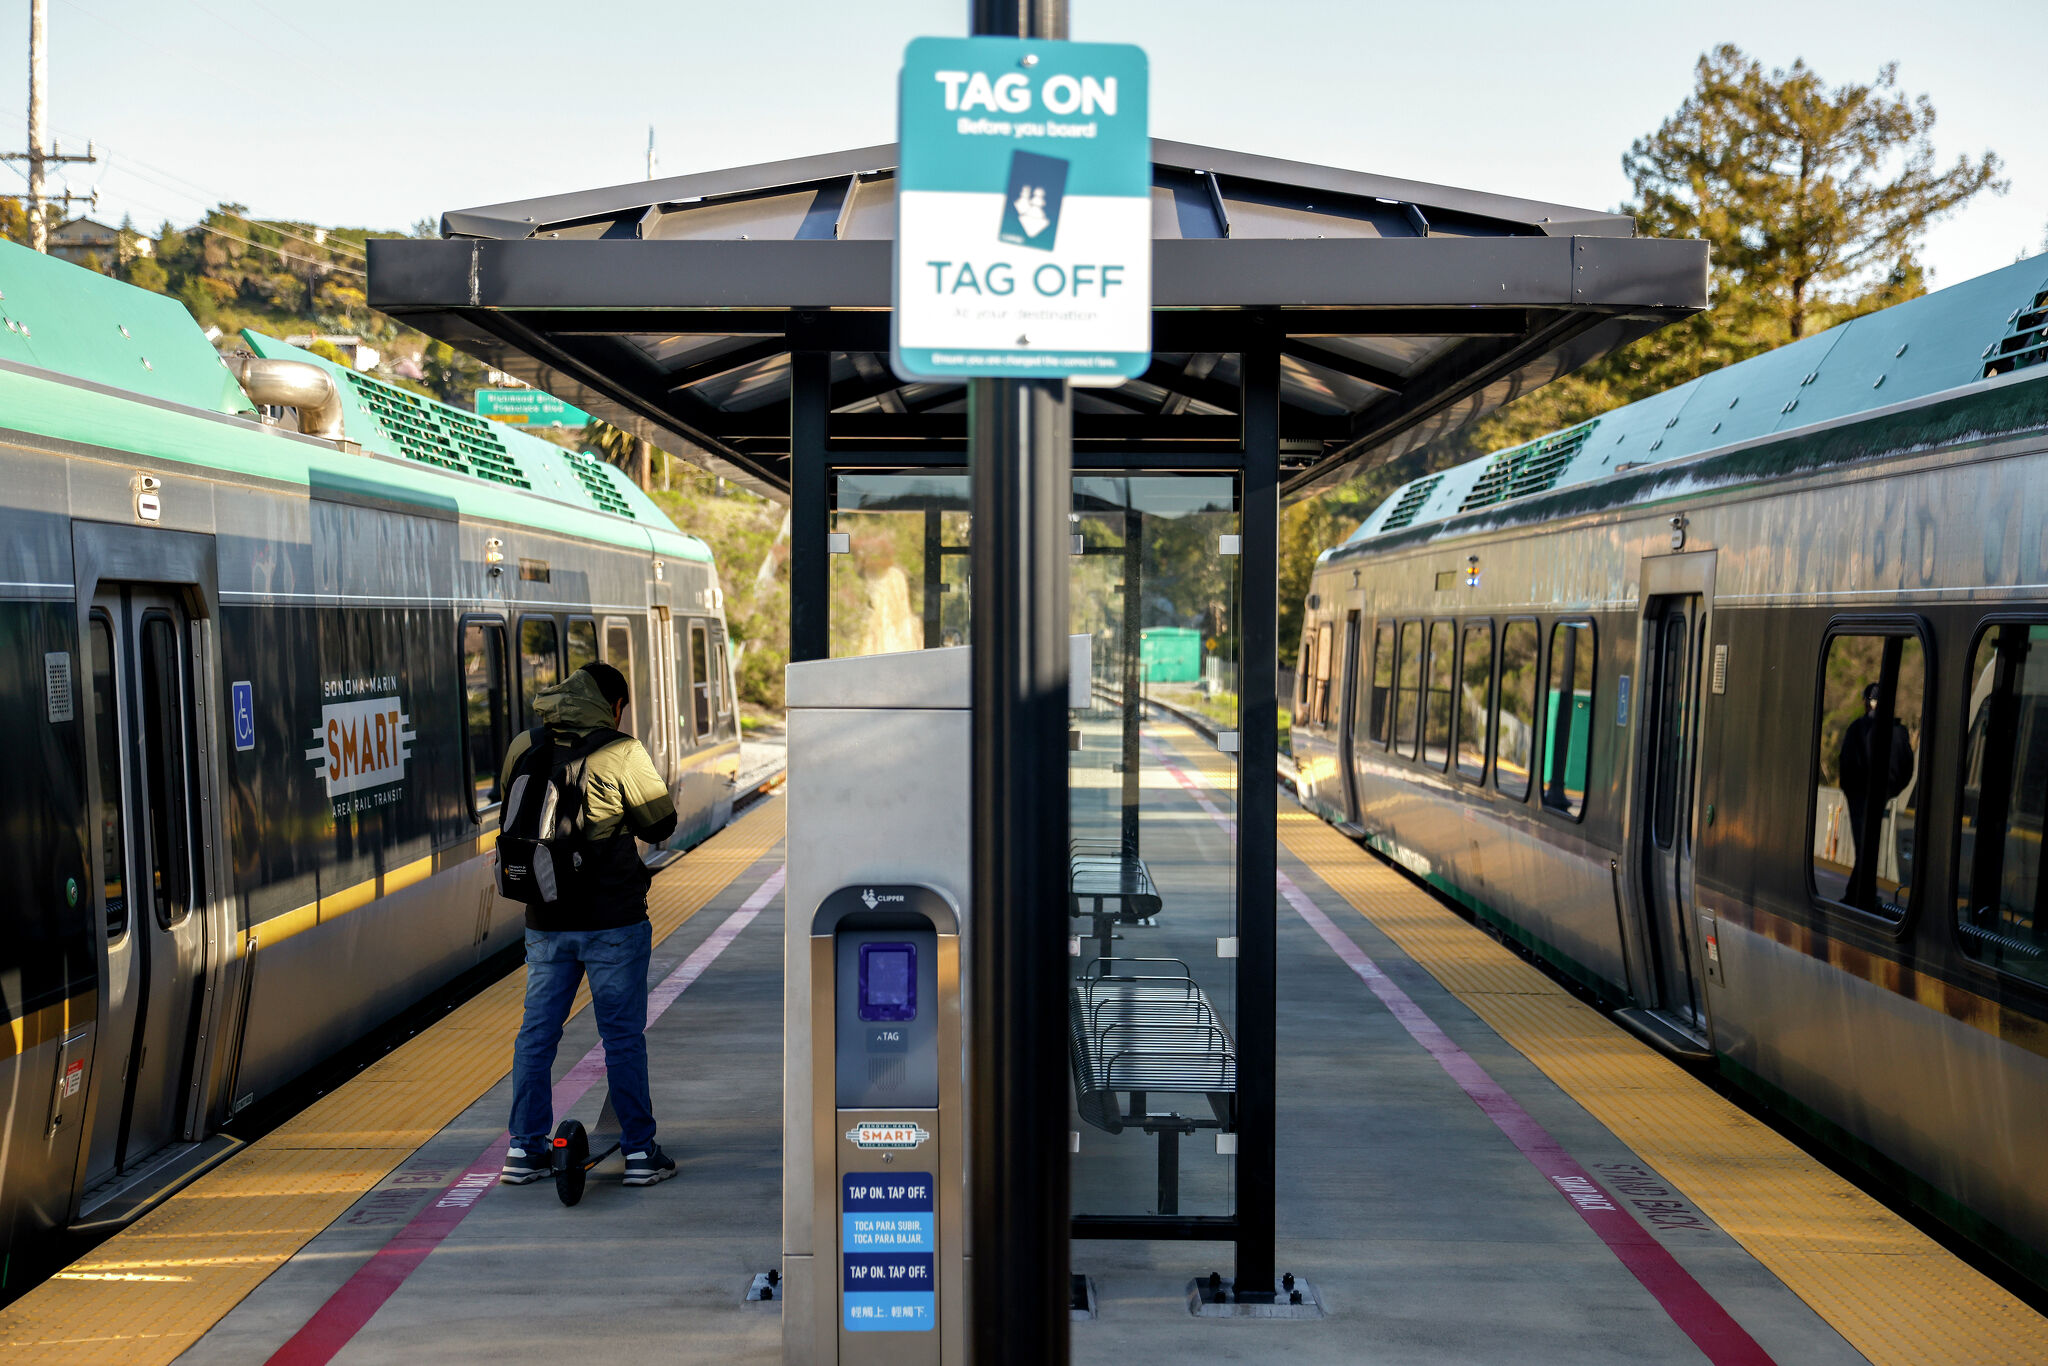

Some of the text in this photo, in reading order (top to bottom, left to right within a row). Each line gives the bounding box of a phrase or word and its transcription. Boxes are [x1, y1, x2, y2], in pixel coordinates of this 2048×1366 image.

[934, 70, 1118, 117] TAG ON
[957, 117, 1098, 138] Before you board
[926, 261, 1125, 298] TAG OFF
[327, 710, 399, 782] SMART
[332, 787, 403, 818] AREA RAIL TRANSIT
[882, 1031, 899, 1041] TAG
[862, 1130, 913, 1141] SMART
[435, 1172, 500, 1208] STAND BACK
[849, 1186, 927, 1199] TAP ON. TAP OFF.
[1551, 1175, 1616, 1211] STAND BACK
[1592, 1163, 1711, 1231] STAND BACK
[853, 1233, 923, 1244] TOCA PARA BAJAR.
[854, 1220, 922, 1231] TOCA PARA SUBIR.
[850, 1265, 928, 1278] TAP ON. TAP OFF.
